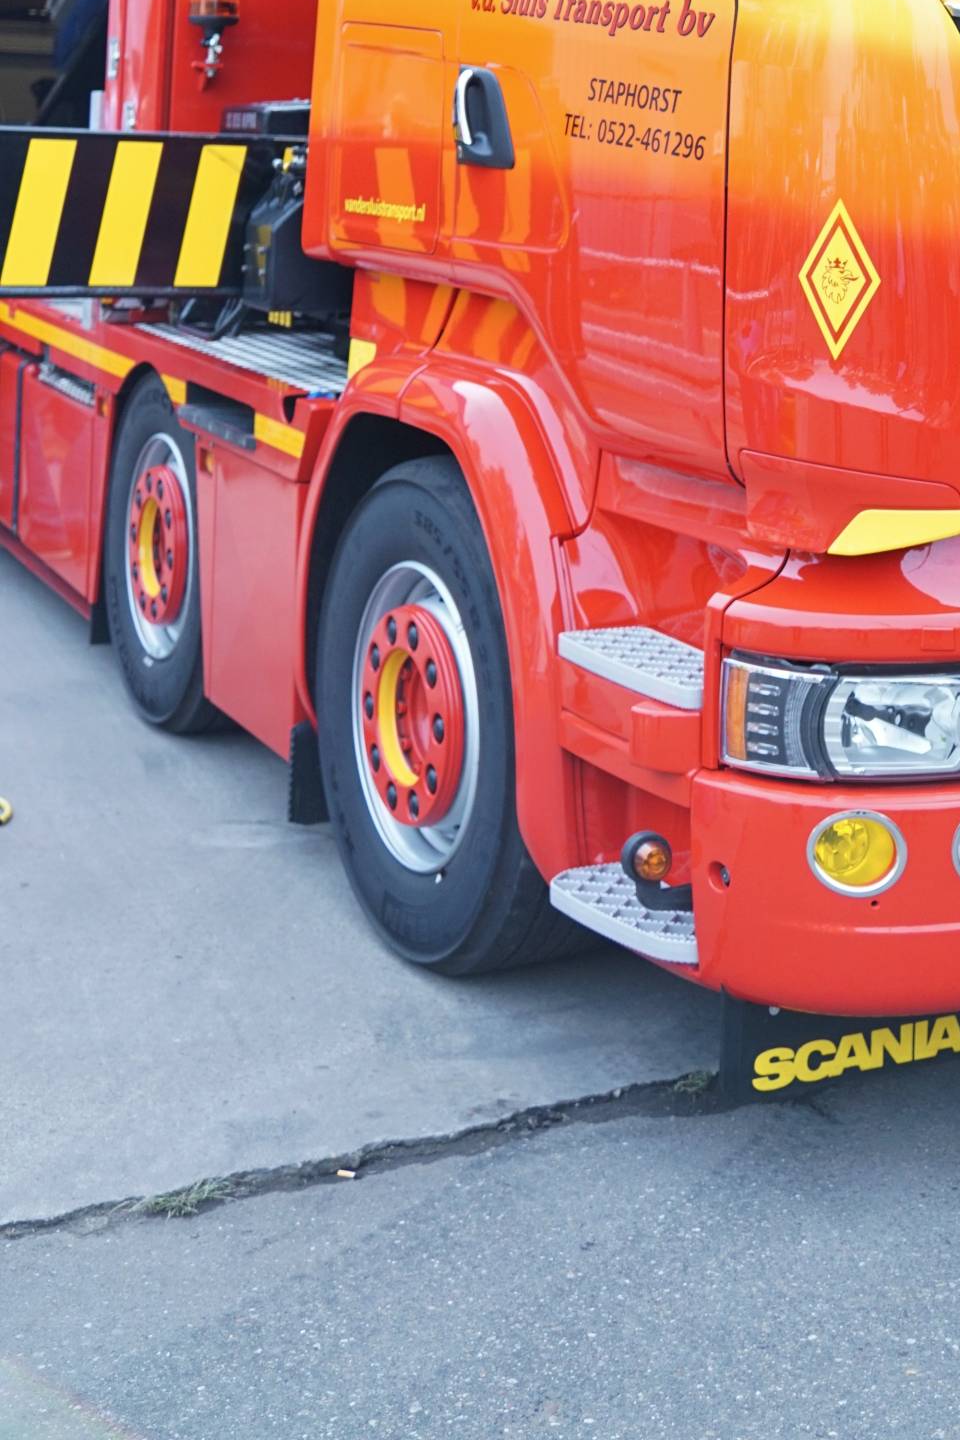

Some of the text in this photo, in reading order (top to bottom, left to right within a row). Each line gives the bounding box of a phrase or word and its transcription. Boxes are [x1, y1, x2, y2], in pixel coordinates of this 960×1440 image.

[588, 78, 682, 114] STAPHORST
[564, 113, 706, 160] TEL: 0522-461296
